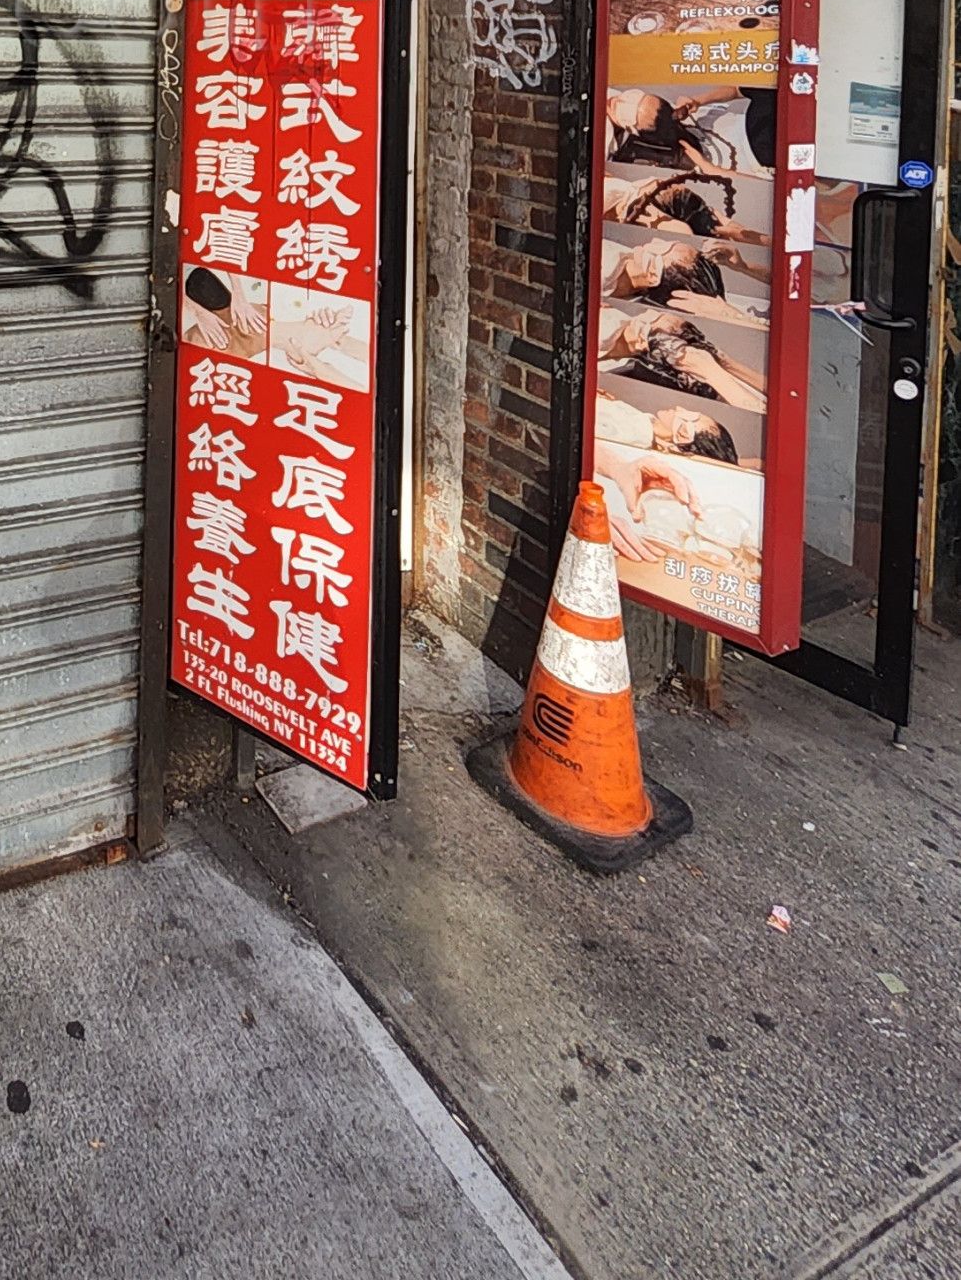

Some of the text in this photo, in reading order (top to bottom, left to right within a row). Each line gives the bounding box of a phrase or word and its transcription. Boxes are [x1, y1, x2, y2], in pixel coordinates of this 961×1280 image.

[671, 63, 707, 73] THAI
[193, 2, 268, 273] 美容護膚
[904, 169, 928, 180] ADT
[186, 356, 260, 641] 經絡養生
[269, 379, 356, 694] 足底保健
[183, 649, 352, 757] 135-20 ROOSEVELT AVE
[184, 668, 348, 772] 2 FL Flushing NY 11354
